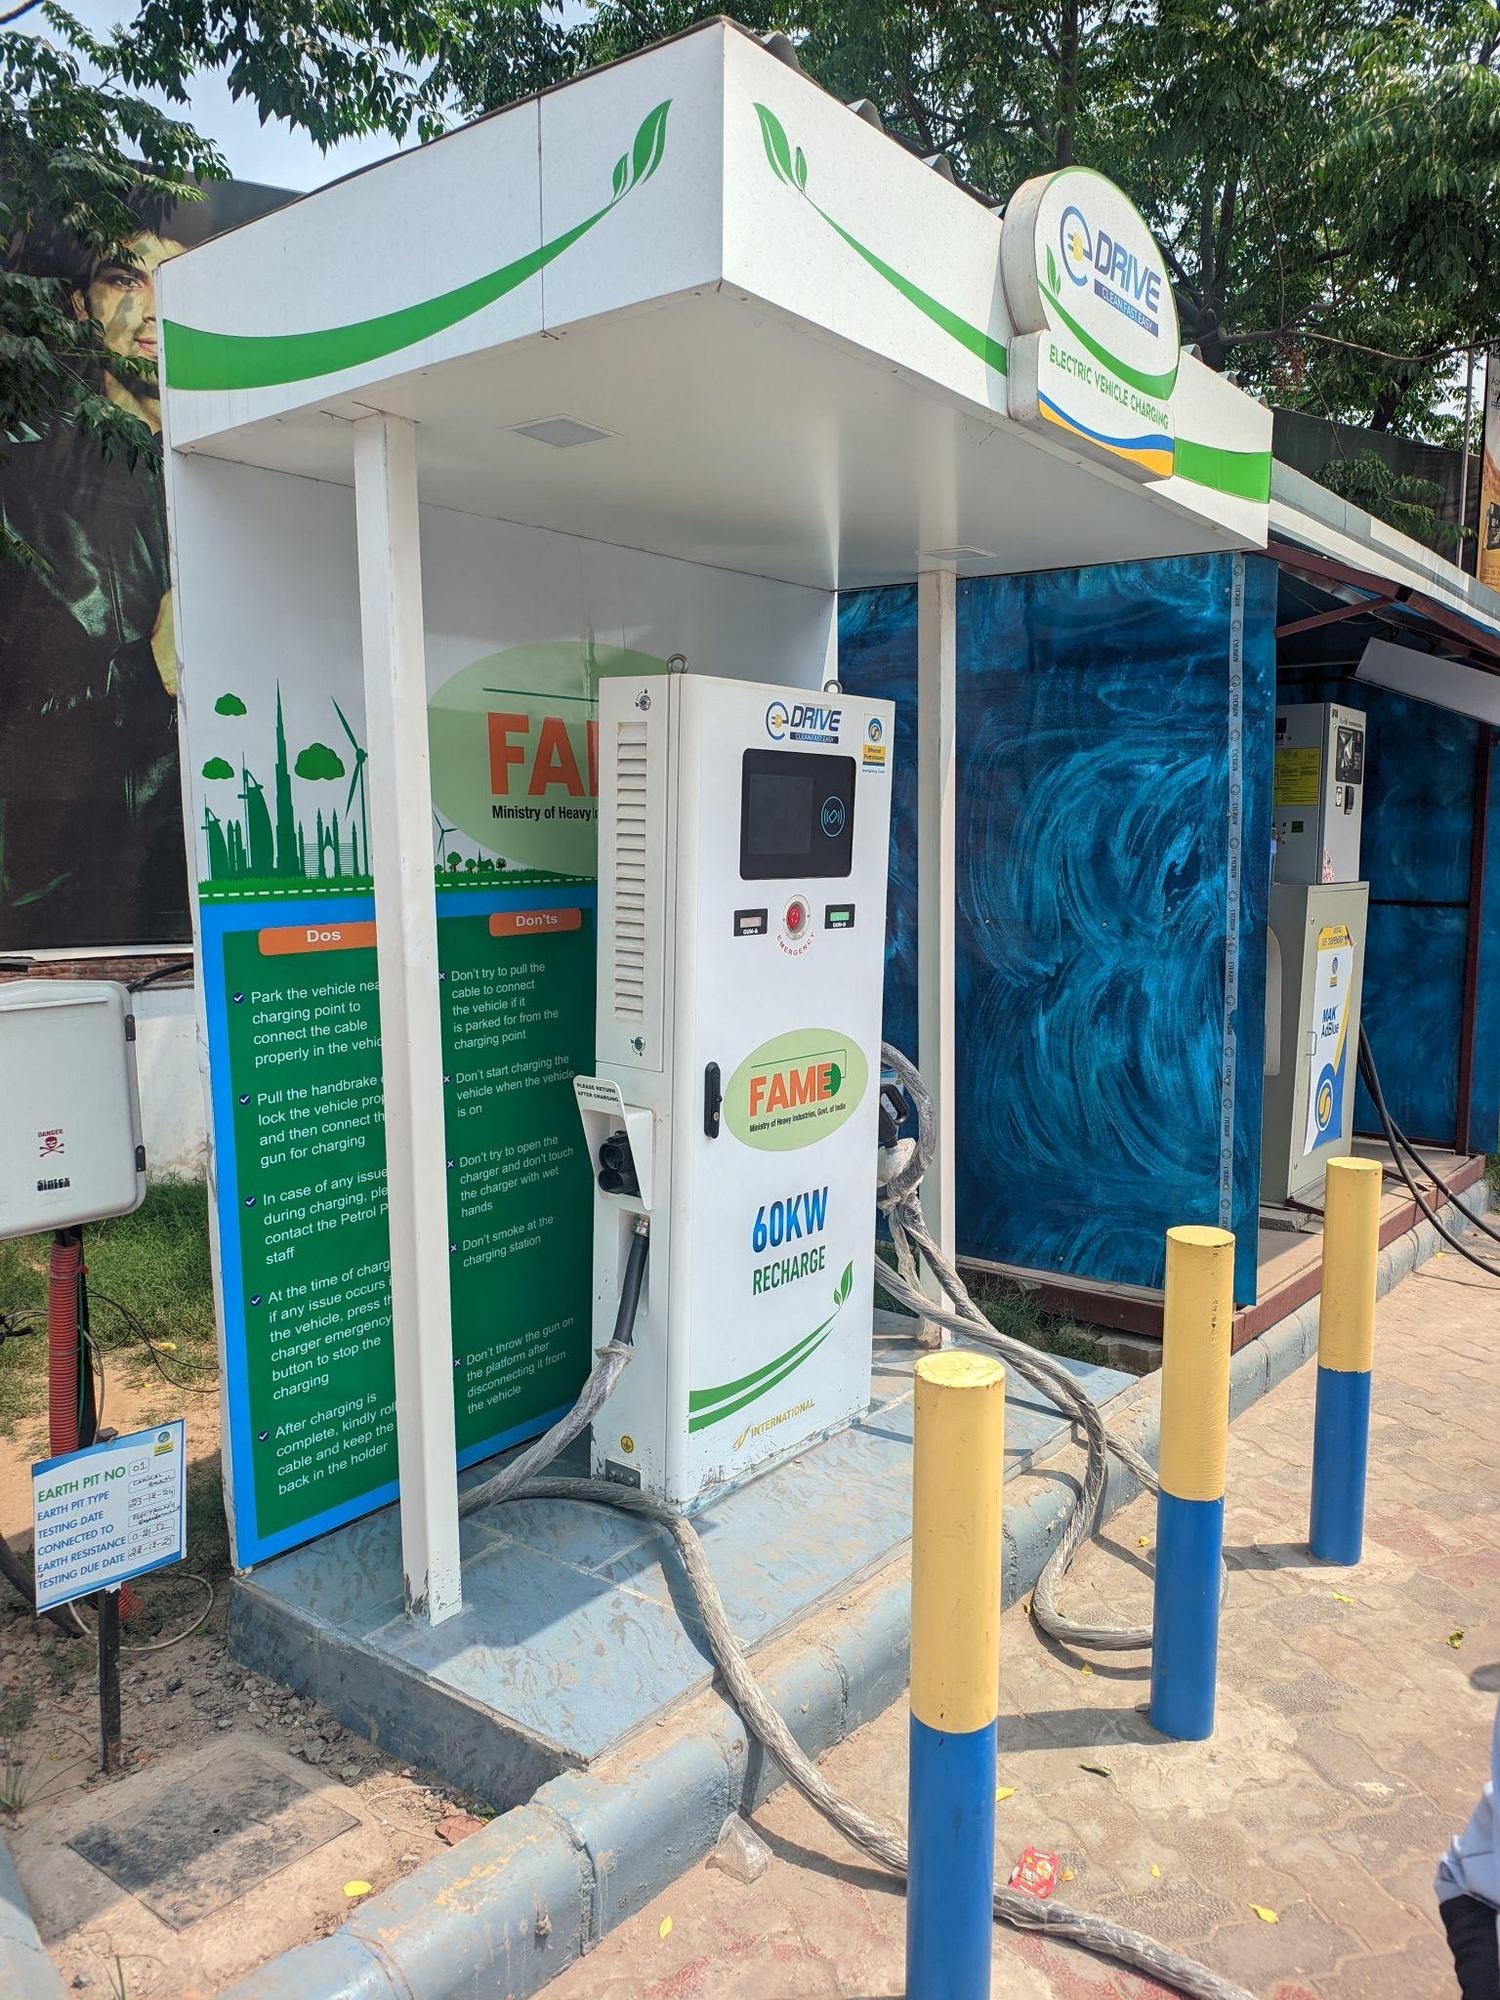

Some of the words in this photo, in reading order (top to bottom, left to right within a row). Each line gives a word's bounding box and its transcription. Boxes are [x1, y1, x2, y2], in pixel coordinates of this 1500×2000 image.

[1049, 344, 1092, 385] ELECTRIC
[1094, 369, 1129, 406] VEHICLE
[1130, 393, 1169, 431] CHARGING
[492, 805, 540, 821] Ministry
[544, 806, 555, 819] of
[559, 806, 591, 821] Heavy
[515, 913, 557, 926] Don'ts
[306, 929, 340, 942] Dos
[776, 931, 815, 956] EMERGENCY
[451, 968, 479, 981] Don't
[481, 968, 495, 979] try
[510, 963, 527, 977] pull
[251, 989, 282, 1003] Park
[311, 981, 355, 996] vehicle
[360, 980, 380, 991] nea
[451, 986, 480, 998] cable
[495, 979, 534, 993] connect
[252, 1007, 310, 1024] charging
[314, 1002, 345, 1019] point
[472, 999, 508, 1012] vehicle
[1322, 1007, 1338, 1023] MAK
[253, 1026, 307, 1044] connect
[334, 1019, 367, 1033] cable
[465, 1016, 500, 1033] parked
[503, 1014, 517, 1025] for
[519, 1012, 541, 1023] from
[1320, 1022, 1340, 1039] AdBlue
[255, 1047, 309, 1068] properly
[352, 1037, 382, 1050] vehic
[454, 1034, 498, 1049] charging
[501, 1029, 526, 1044] point
[455, 1069, 483, 1083] Don't
[485, 1064, 508, 1077] start
[510, 1058, 552, 1073] charging
[456, 1084, 492, 1100] vehicle
[495, 1080, 522, 1092] when
[542, 1069, 575, 1085] vehicle
[257, 1089, 282, 1105] Pull
[311, 1075, 377, 1096] handbrake
[594, 1094, 619, 1102] CHARGING
[596, 1086, 616, 1094] RETURN
[749, 1063, 832, 1117] FAME
[258, 1110, 285, 1125] lock
[313, 1097, 357, 1114] vehicle
[749, 1121, 770, 1132] Ministry
[771, 1118, 777, 1127] of
[777, 1116, 792, 1126] Heavy
[792, 1110, 817, 1122] Industries,
[817, 1107, 829, 1116] Govt.
[829, 1104, 835, 1113] of
[835, 1102, 846, 1111] India
[38, 1129, 63, 1137] DANGER
[259, 1129, 284, 1145] and
[288, 1126, 317, 1139] then
[321, 1113, 370, 1133] connect
[374, 1112, 384, 1125] th
[260, 1152, 285, 1168] gun
[289, 1147, 307, 1159] for
[311, 1135, 365, 1154] charging
[459, 1151, 486, 1167] Don't
[489, 1149, 502, 1161] try
[516, 1140, 540, 1154] open
[459, 1166, 499, 1184] charger
[501, 1159, 520, 1173] and
[522, 1153, 546, 1167] don't
[548, 1146, 573, 1161] touch
[37, 1178, 70, 1191] Sintex
[279, 1186, 311, 1201] case
[330, 1176, 353, 1189] any
[357, 1167, 388, 1183] issue
[479, 1178, 518, 1195] charger
[520, 1171, 539, 1184] with
[542, 1165, 558, 1178] wet
[263, 1207, 305, 1225] during
[309, 1192, 366, 1213] charging,
[371, 1184, 389, 1201] ple
[461, 1200, 492, 1217] hands
[752, 1186, 829, 1254] 60KW
[264, 1222, 313, 1244] contact
[340, 1205, 376, 1224] Petrol
[380, 1203, 389, 1215] P
[462, 1233, 489, 1250] Don't
[492, 1224, 524, 1241] smoke
[265, 1246, 294, 1264] staff
[463, 1246, 506, 1267] charging
[509, 1235, 540, 1252] station
[310, 1275, 337, 1291] time
[356, 1259, 390, 1278] charg
[752, 1245, 827, 1297] RECHARGE
[280, 1304, 304, 1320] any
[308, 1293, 341, 1311] issue
[345, 1280, 385, 1299] occurs
[294, 1312, 342, 1334] vehicle,
[347, 1300, 380, 1320] press
[270, 1337, 321, 1361] charger
[324, 1315, 393, 1343] emergency
[466, 1346, 493, 1365] Don't
[495, 1336, 523, 1354] throw
[542, 1322, 559, 1337] gun
[272, 1360, 312, 1381] button
[332, 1344, 358, 1360] stop
[467, 1363, 534, 1397] disconnecting
[545, 1351, 565, 1365] from
[485, 1351, 525, 1376] platform
[527, 1342, 549, 1357] after
[273, 1373, 328, 1400] charging
[486, 1385, 521, 1405] vehicle
[275, 1419, 306, 1439] After
[310, 1398, 363, 1424] charging
[276, 1428, 338, 1456] complete,
[342, 1410, 376, 1431] kindly
[380, 1402, 395, 1416] rol
[751, 1398, 816, 1438] INTERNATIONAL
[277, 1455, 312, 1476] cable
[315, 1441, 339, 1460] and
[343, 1431, 372, 1449] keep
[278, 1474, 309, 1495] back
[350, 1442, 387, 1465] holder
[38, 1479, 78, 1502] EARTH
[83, 1473, 100, 1488] PIT
[104, 1466, 125, 1481] NO
[37, 1503, 68, 1521] EARTH
[71, 1496, 86, 1510] PIT
[87, 1490, 110, 1507] TYPE
[37, 1518, 77, 1539] TESTING
[80, 1510, 103, 1525] DATE
[37, 1529, 98, 1555] CONNECTED
[99, 1523, 114, 1535] TO
[37, 1556, 67, 1573] EARTH
[71, 1536, 126, 1561] RESISTANCE
[37, 1569, 77, 1590] TESTING
[80, 1561, 99, 1575] DUE
[102, 1552, 126, 1568] DATE
